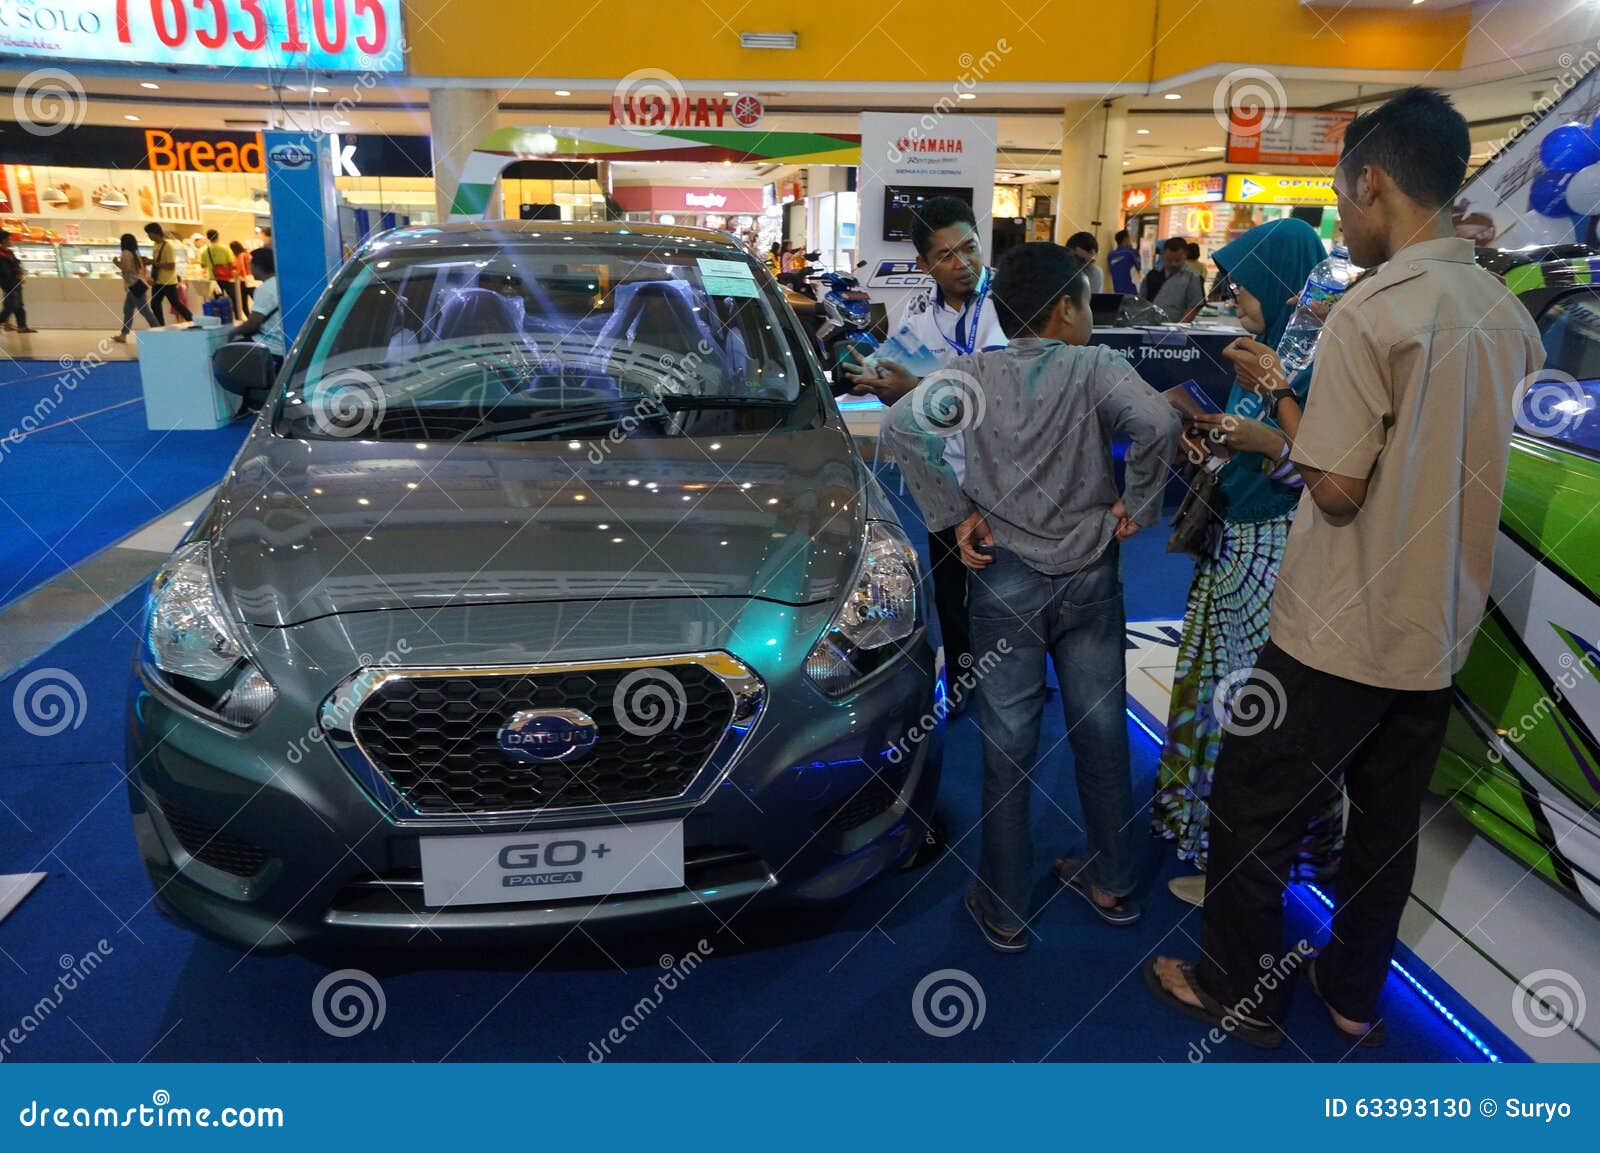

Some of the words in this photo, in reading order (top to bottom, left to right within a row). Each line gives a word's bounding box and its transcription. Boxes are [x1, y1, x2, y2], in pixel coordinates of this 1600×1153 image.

[16, 7, 101, 34] SOLO
[144, 128, 266, 173] Bread
[911, 138, 964, 153] YAMAHA
[1139, 346, 1200, 361] Through
[508, 729, 588, 744] DATSUN
[509, 873, 576, 885] PANCA
